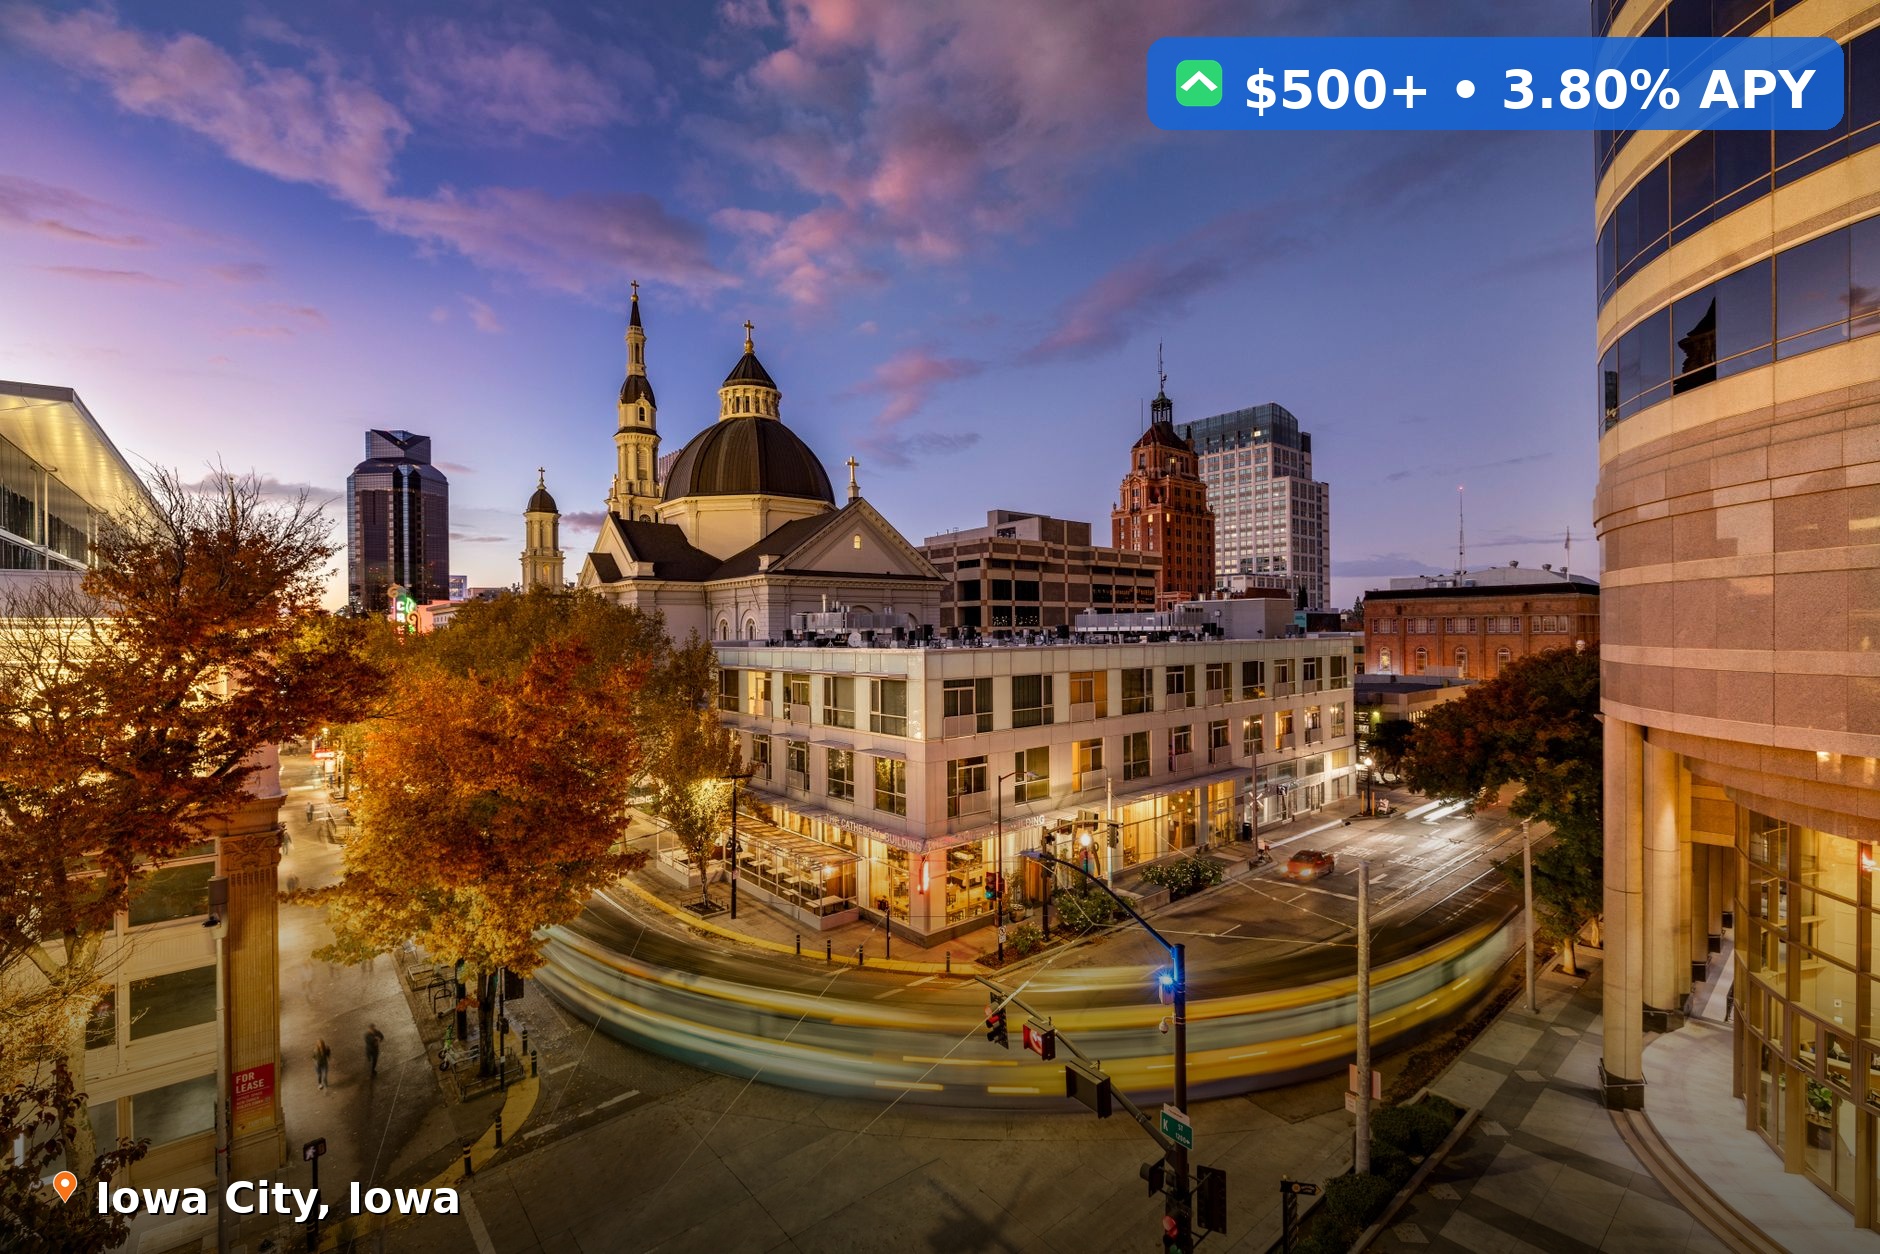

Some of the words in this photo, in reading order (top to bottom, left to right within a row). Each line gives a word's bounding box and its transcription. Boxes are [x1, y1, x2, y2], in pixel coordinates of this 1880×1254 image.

[884, 832, 922, 853] BUILDING
[236, 1072, 255, 1084] FOR
[236, 1079, 264, 1094] LEASE
[1163, 1118, 1169, 1131] K
